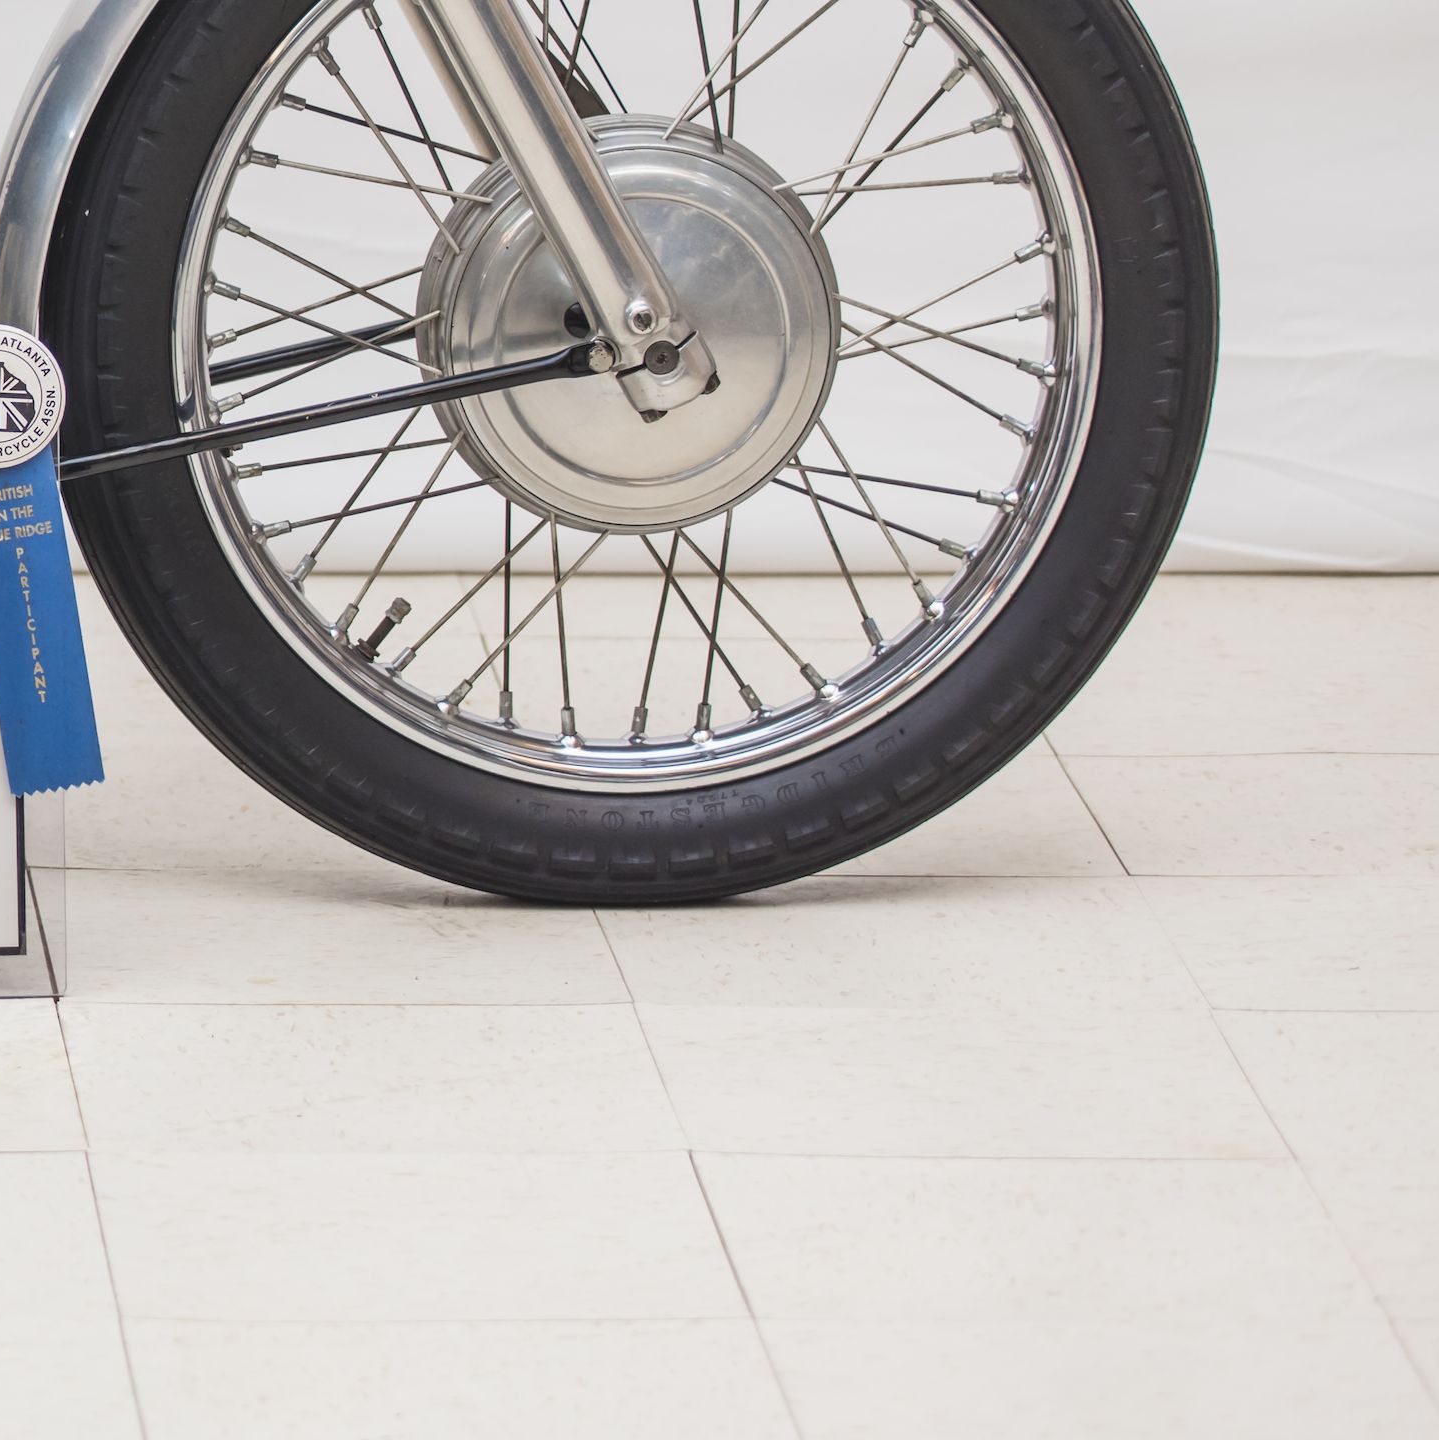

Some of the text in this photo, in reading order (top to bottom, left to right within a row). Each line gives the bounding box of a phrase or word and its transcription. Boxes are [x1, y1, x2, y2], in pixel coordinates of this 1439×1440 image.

[0, 336, 51, 377] ATLANTA
[41, 385, 56, 427] ASSN.
[10, 505, 34, 520] THE
[14, 521, 53, 538] RIDGE
[16, 547, 47, 703] PARTICIPANT
[528, 735, 901, 831] BRIDGESTONE
